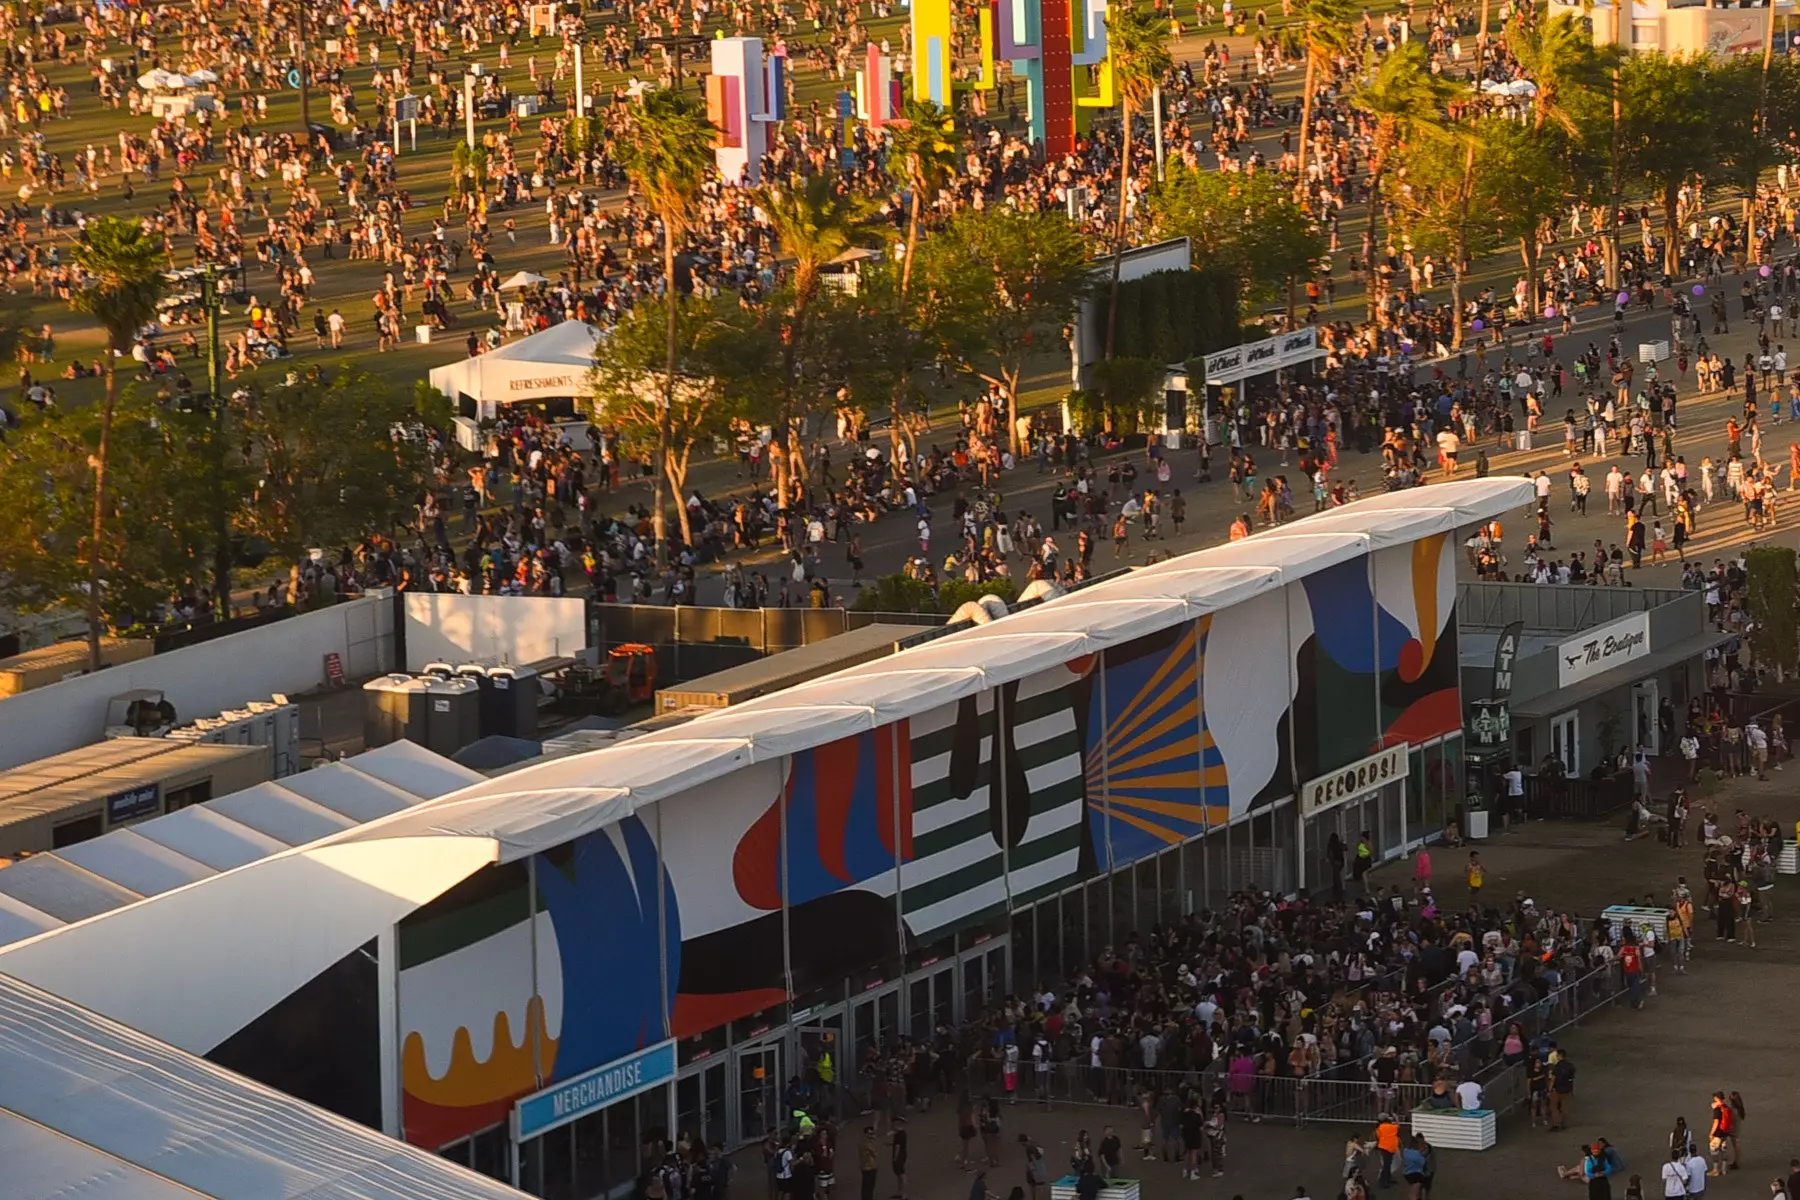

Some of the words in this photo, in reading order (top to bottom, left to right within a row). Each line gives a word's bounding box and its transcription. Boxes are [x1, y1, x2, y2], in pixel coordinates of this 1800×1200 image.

[510, 376, 573, 391] REFRESHMENTS
[1496, 635, 1514, 690] ATM
[1583, 640, 1600, 665] The
[1602, 631, 1644, 657] Boutique
[1480, 708, 1492, 743] ATM
[1314, 753, 1396, 806] RECORDS!
[553, 1061, 642, 1117] MERCHANDISE
